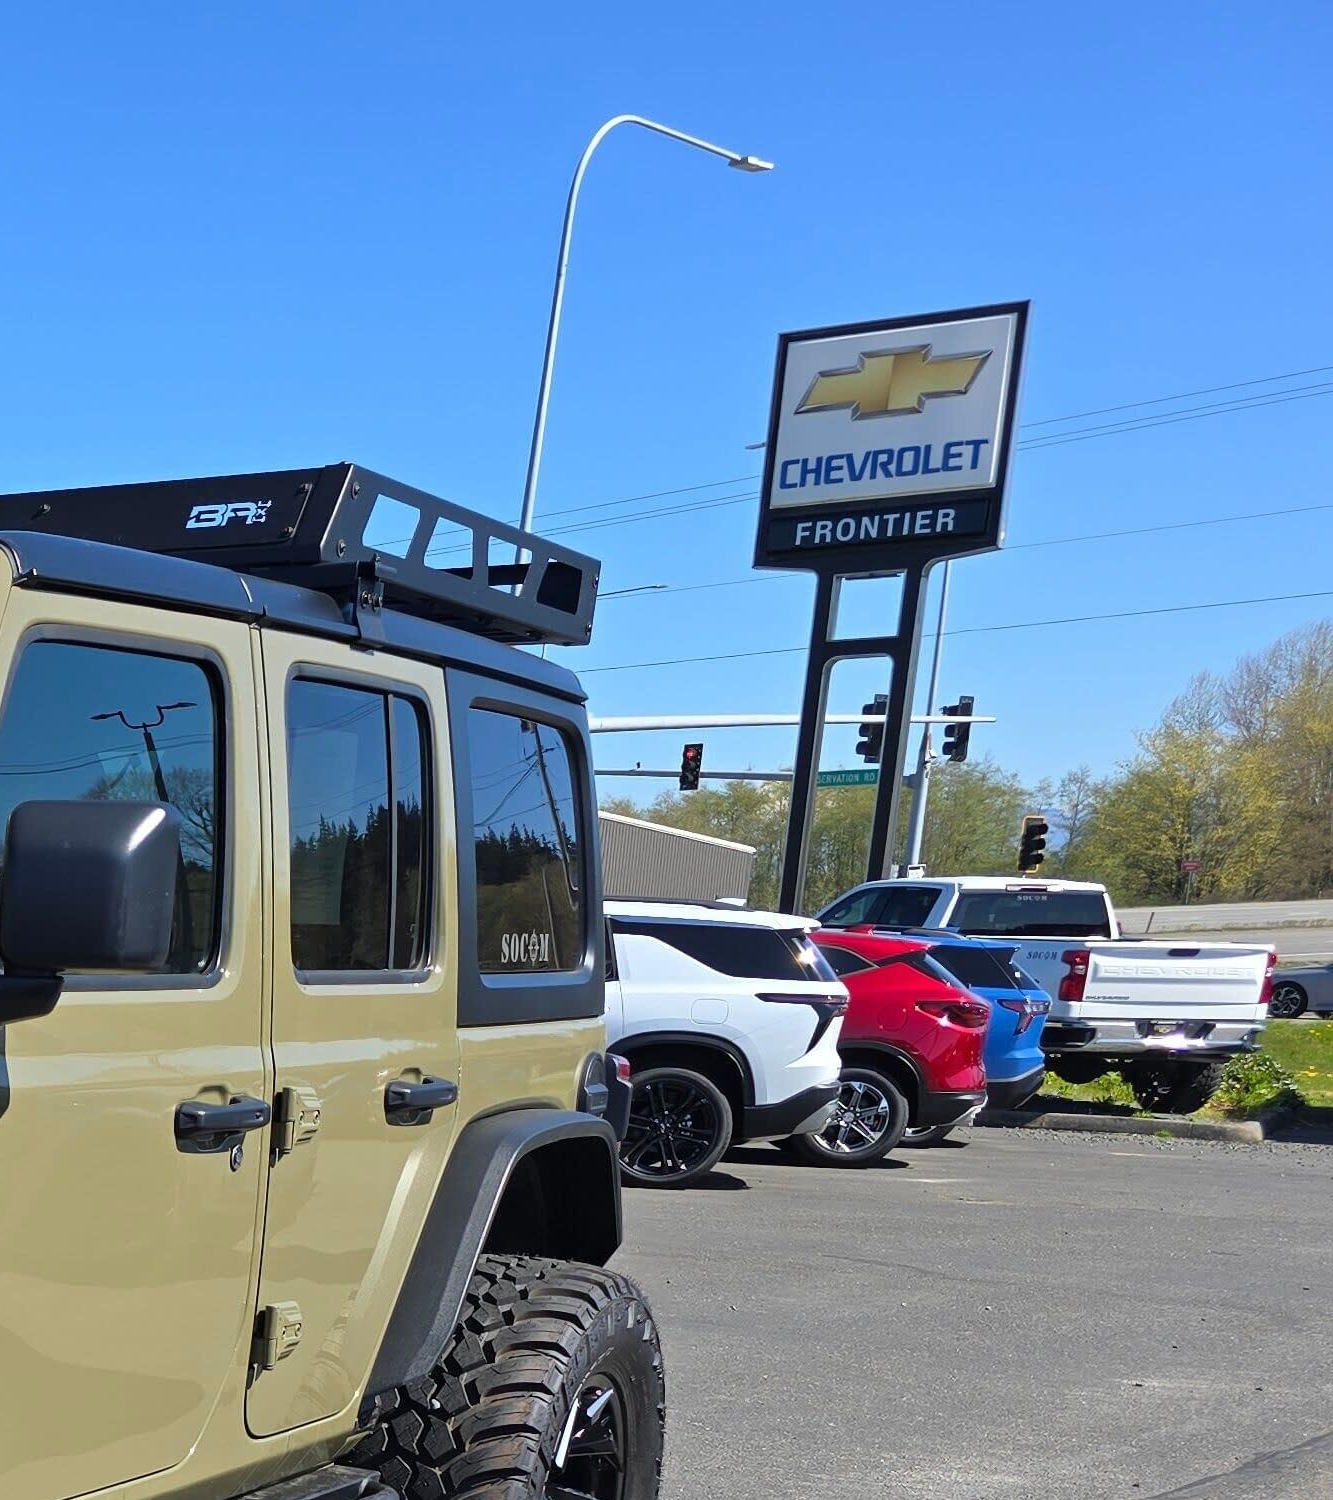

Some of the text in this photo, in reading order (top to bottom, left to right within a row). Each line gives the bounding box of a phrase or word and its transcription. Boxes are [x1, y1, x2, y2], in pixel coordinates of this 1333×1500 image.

[778, 438, 989, 490] CHEVROLET
[794, 507, 957, 547] FRONTIER
[863, 771, 876, 783] RD
[500, 930, 551, 966] SOCOM
